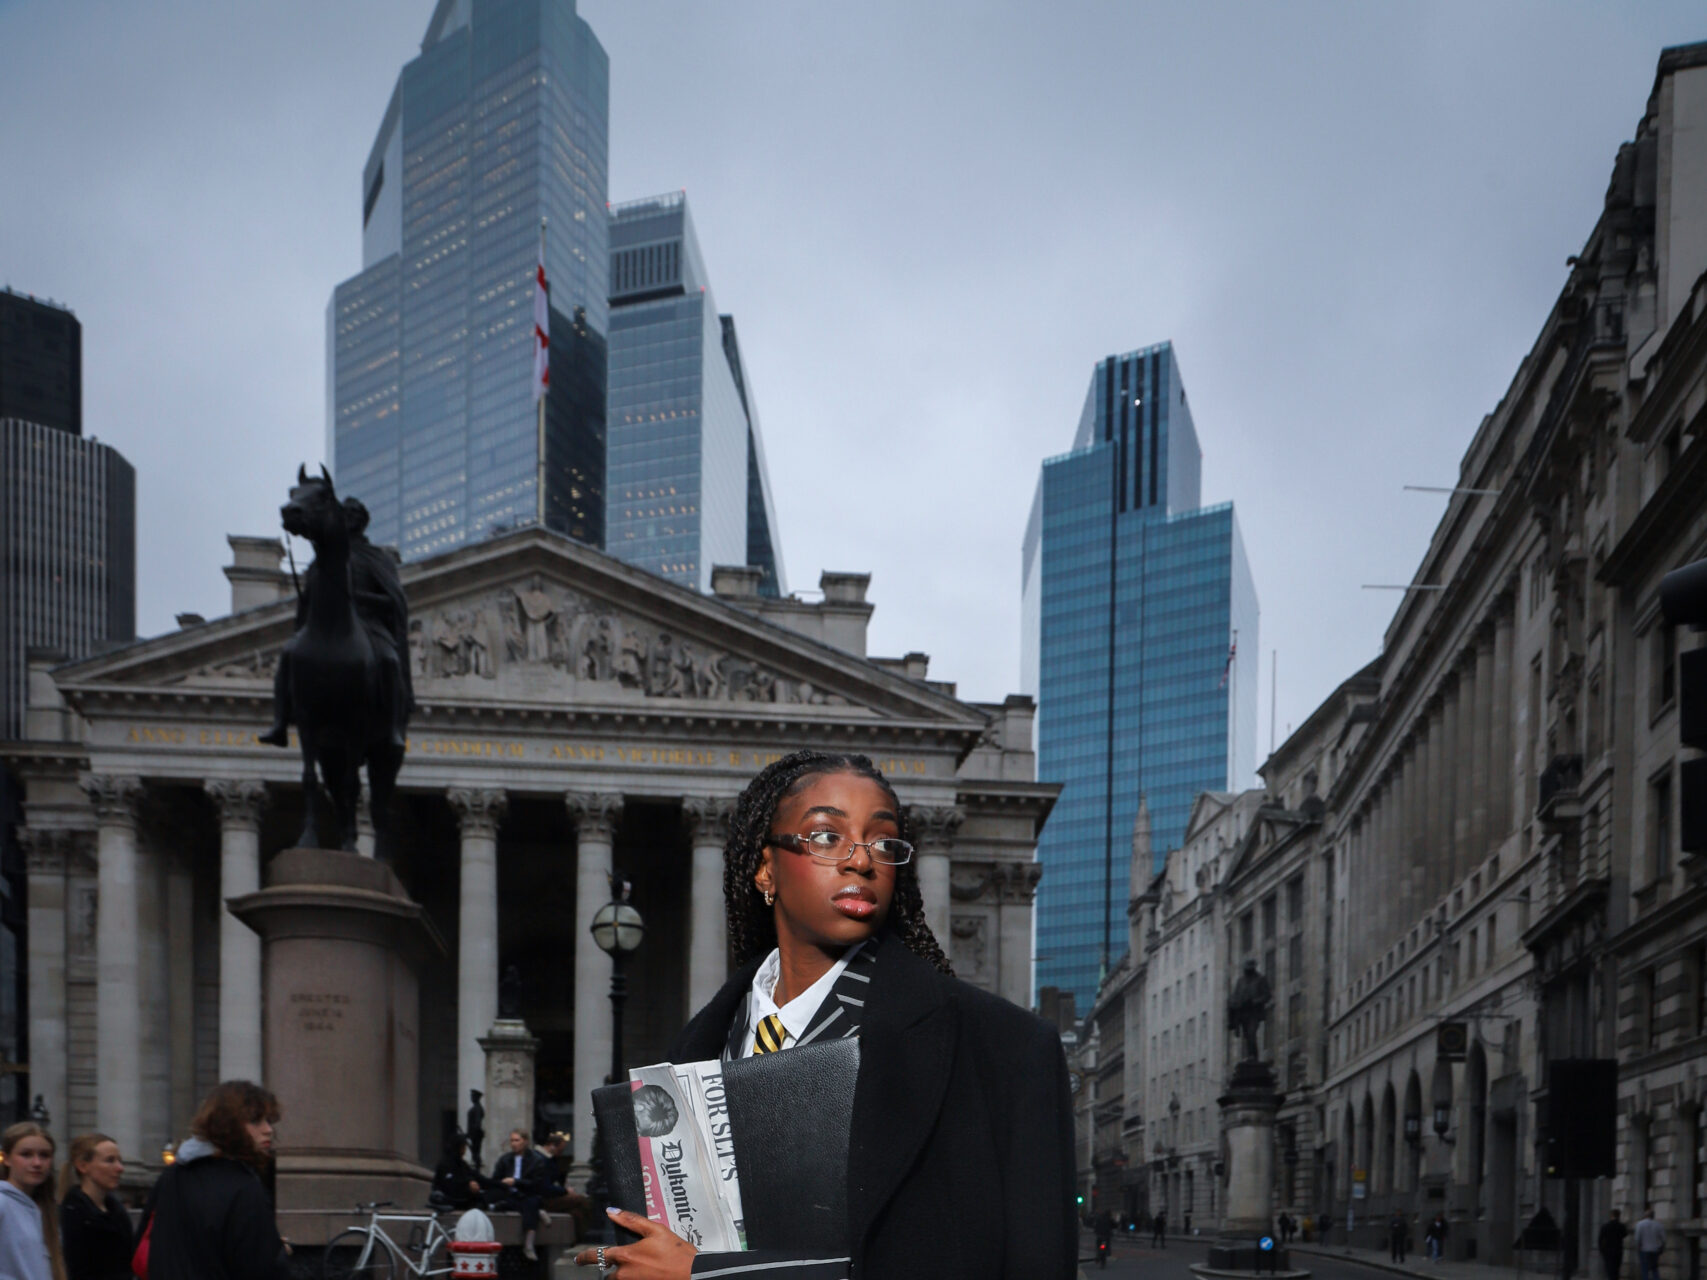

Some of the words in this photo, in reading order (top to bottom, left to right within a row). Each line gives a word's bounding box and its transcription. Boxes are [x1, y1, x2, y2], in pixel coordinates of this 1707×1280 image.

[127, 727, 187, 743] ANNO
[552, 744, 606, 760] ANNO
[702, 1073, 728, 1119] FOR
[661, 1139, 697, 1223] Dykonic
